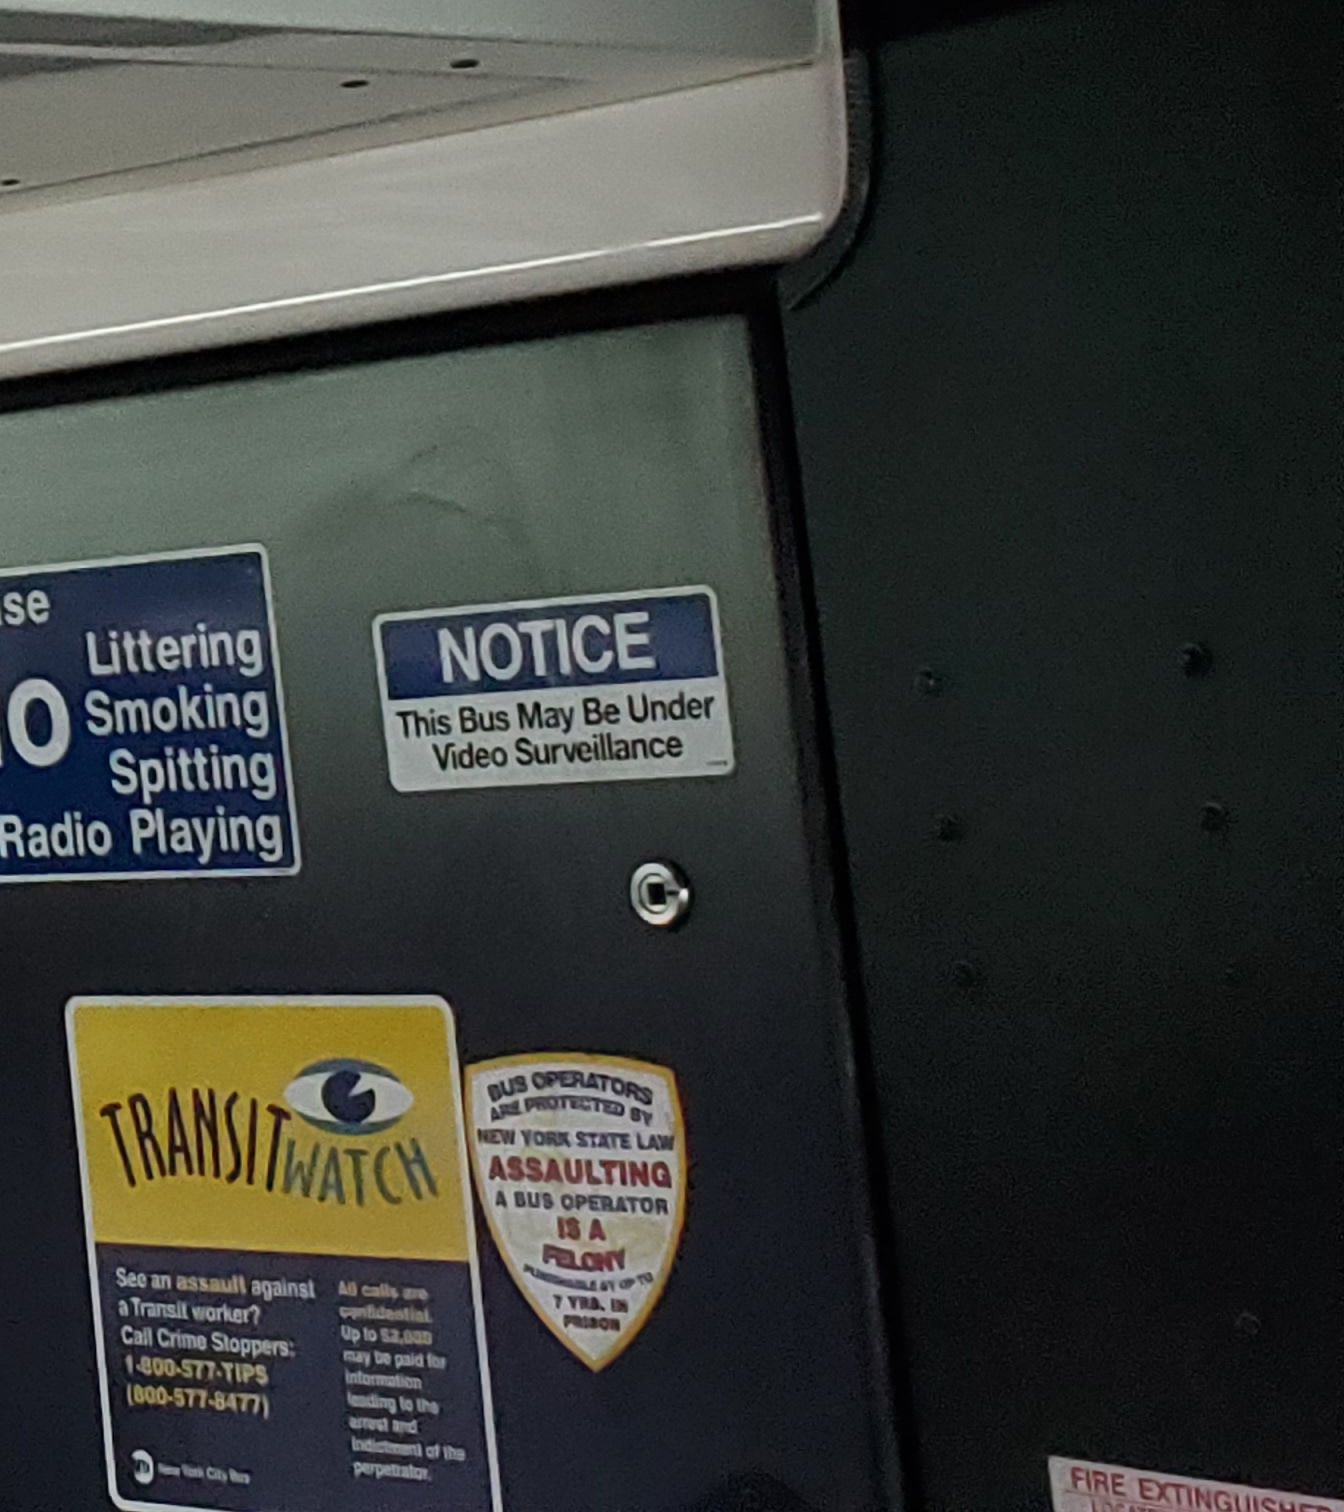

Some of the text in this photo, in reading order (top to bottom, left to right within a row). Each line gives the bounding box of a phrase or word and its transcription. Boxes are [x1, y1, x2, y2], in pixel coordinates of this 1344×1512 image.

[85, 622, 264, 678] Littering
[436, 611, 657, 684] NOTICE
[84, 683, 270, 739] Smoking
[396, 691, 715, 739] This Bus May Be Under
[432, 733, 684, 772] Video Surveillance
[109, 744, 277, 804] Spitting
[129, 806, 284, 865] Playing
[487, 1071, 653, 1105] BUS OPERATORS
[490, 1095, 653, 1126] ARE PROTECTED BY
[477, 1128, 675, 1150] NEW YORK STATE LAW
[489, 1155, 672, 1188] ASSAULTING
[495, 1191, 669, 1214] A BUS OPERATOR
[557, 1216, 606, 1241] IS A
[542, 1243, 626, 1272] FELONY
[116, 1267, 316, 1302] See an assault against
[118, 1297, 260, 1325] a Transit worker?
[553, 1294, 563, 1309] 7
[121, 1325, 296, 1358] Call Crime Stoppers:
[340, 1325, 361, 1344] Up
[363, 1327, 377, 1342] to
[125, 1354, 269, 1385] 1-800-577-TIPS
[394, 1352, 424, 1369] paid
[127, 1383, 269, 1420] (800-577-8477)
[206, 1467, 227, 1482] City
[1070, 1466, 1333, 1512] FIRE EXTINGUISH
